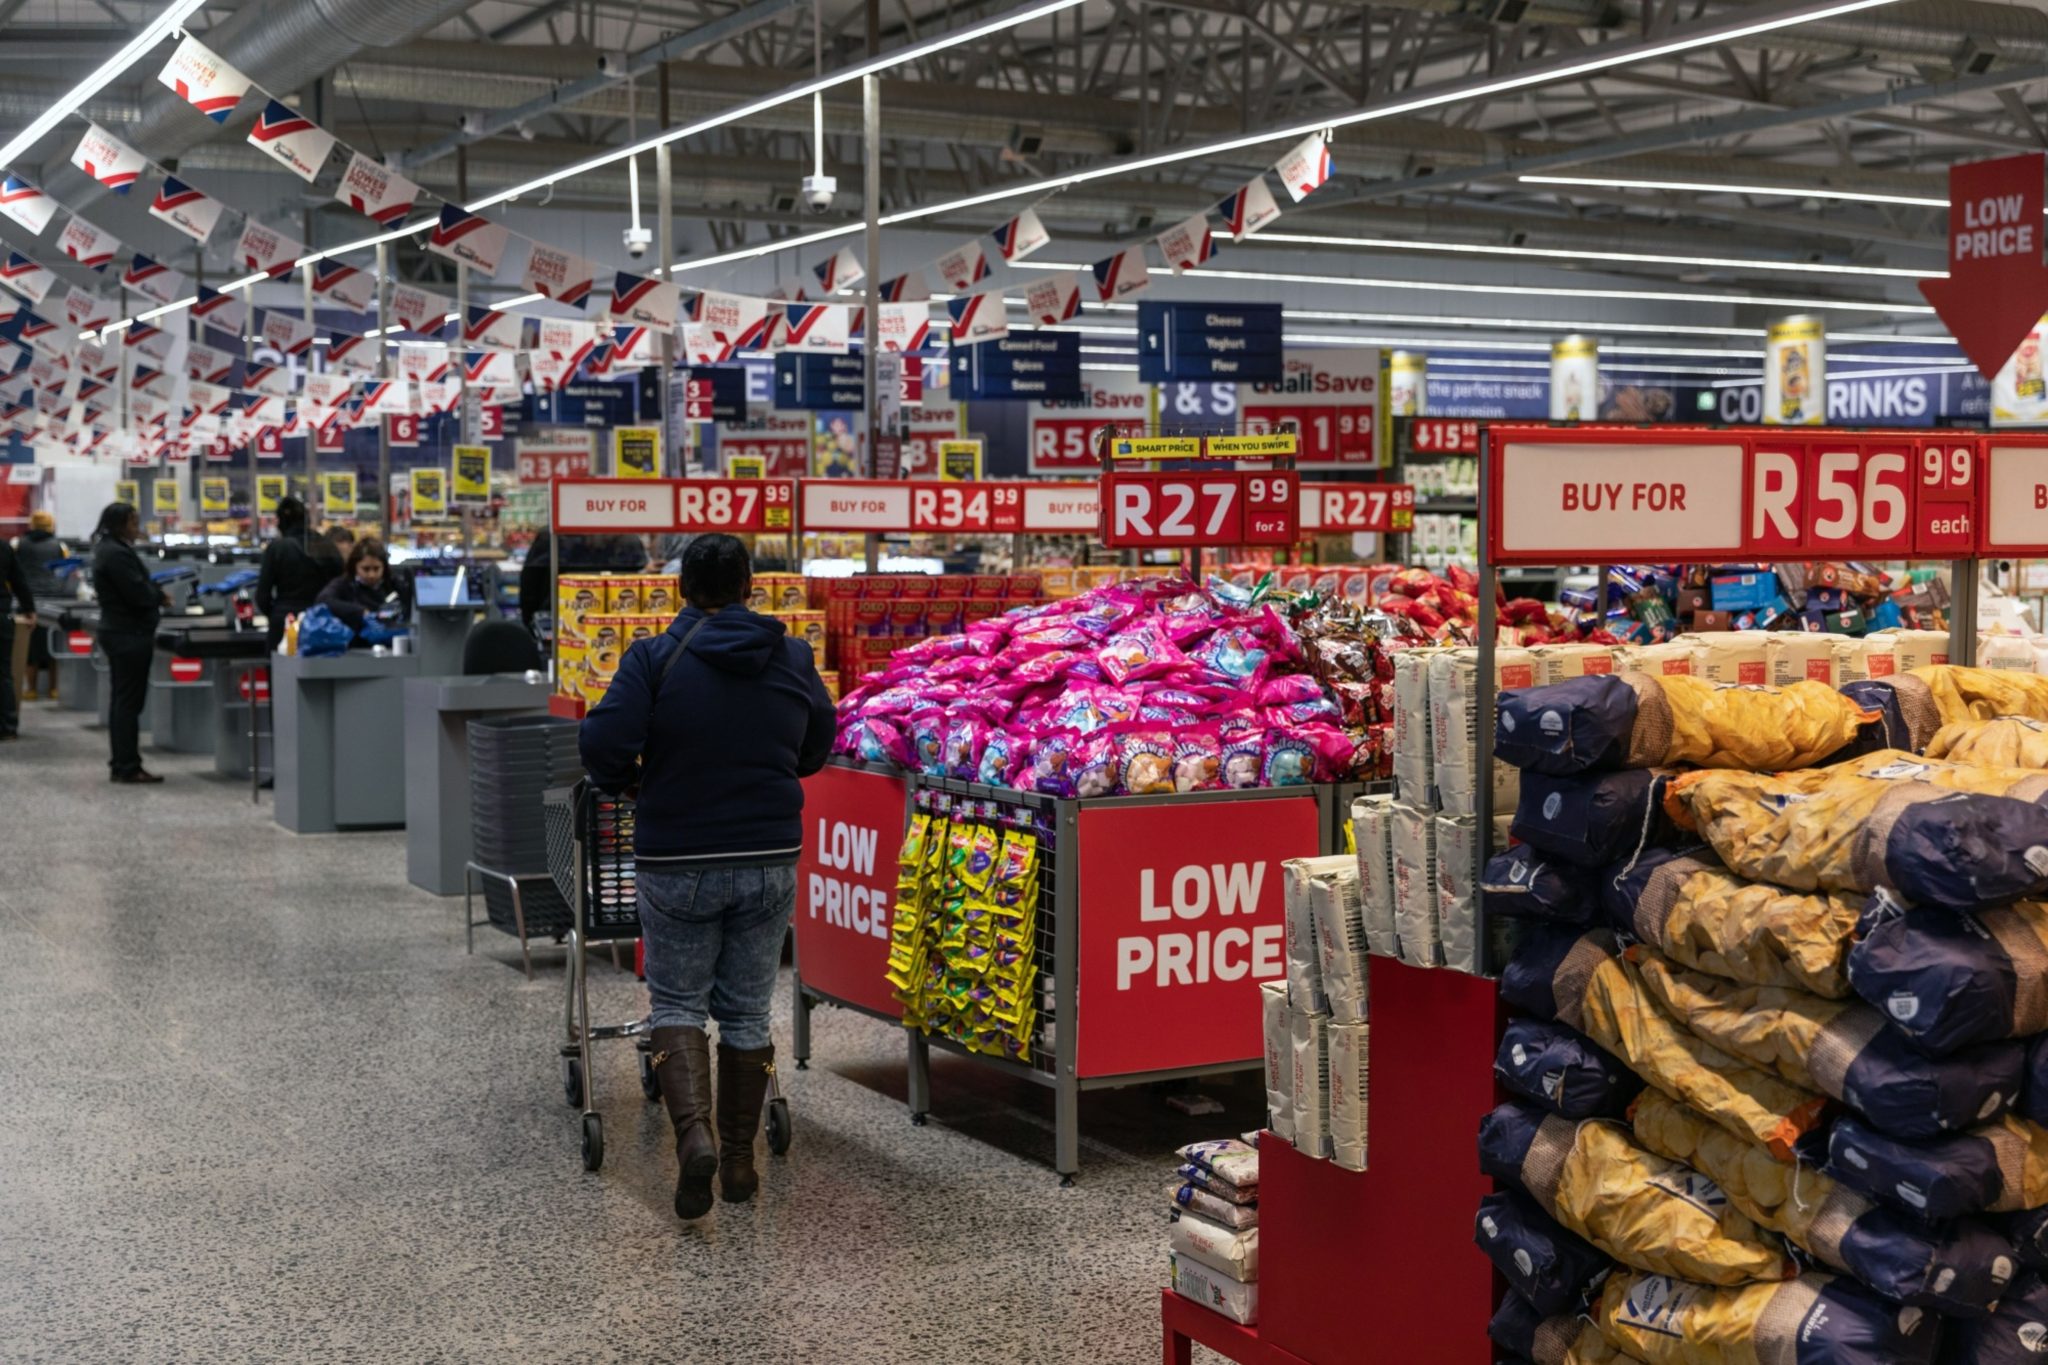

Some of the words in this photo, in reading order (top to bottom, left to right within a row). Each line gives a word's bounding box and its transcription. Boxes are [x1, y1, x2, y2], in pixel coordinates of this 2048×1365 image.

[347, 176, 382, 201] PRICES
[351, 168, 388, 193] LOWER
[1965, 193, 2024, 229] LOW
[1955, 226, 2034, 262] PRICE
[529, 264, 566, 284] PRICES
[531, 256, 568, 276] LOWER
[705, 306, 740, 320] LOWER
[705, 315, 739, 328] PRICES
[1205, 313, 1244, 327] Cheese
[999, 339, 1033, 352] Canned
[1034, 340, 1058, 352] Food
[1148, 334, 1158, 349] 1
[1205, 337, 1246, 352] Yoghurt
[832, 357, 863, 370] Baking
[900, 358, 909, 375] 1
[1012, 359, 1044, 373] Spices
[1211, 359, 1239, 372] Flour
[688, 382, 701, 398] 3
[900, 382, 909, 399] 2
[1011, 379, 1046, 391] Sauces
[1427, 383, 1449, 398] the
[1451, 383, 1501, 400] perfect
[1503, 383, 1543, 399] snack
[832, 392, 862, 402] Coffee
[1175, 382, 1204, 416] &
[1210, 382, 1236, 416] S
[1720, 388, 1763, 423] CO
[1828, 377, 1928, 420] RINKS
[688, 402, 701, 418] 4
[397, 420, 412, 438] 6
[481, 411, 495, 430] 5
[1339, 414, 1373, 434] 99
[1213, 441, 1240, 452] WHEN
[1242, 441, 1261, 451] YOU
[1261, 440, 1290, 450] SWIPE
[1433, 424, 1460, 449] 15
[1136, 444, 1168, 454] SMART
[1170, 443, 1195, 453] PRICE
[1562, 482, 1624, 512] BUY
[1632, 482, 1687, 512] FOR
[1752, 452, 1908, 541] R56
[1923, 447, 1973, 487] 99
[2034, 483, 2048, 510] B
[586, 499, 615, 513] BUY
[620, 499, 647, 513] FOR
[679, 486, 758, 525] R87
[765, 485, 791, 503] 99
[830, 500, 857, 514] BUY
[861, 500, 887, 514] FOR
[914, 488, 989, 528] R34
[993, 488, 1018, 506] 99
[1048, 502, 1074, 515] BUY
[1077, 502, 1100, 515] FOR
[1114, 483, 1237, 537] R27
[1249, 478, 1289, 503] 99
[1323, 490, 1388, 526] R27
[1392, 490, 1413, 506] 99
[1255, 520, 1274, 532] for
[1276, 520, 1285, 532] 2
[1930, 514, 1971, 535] each
[1440, 716, 1448, 749] FLOUR
[819, 818, 878, 877] LOW
[1140, 861, 1267, 922] LOW
[808, 872, 889, 940] PRICE
[1117, 924, 1284, 991] PRICE
[1802, 1303, 1827, 1343] POTATOES
